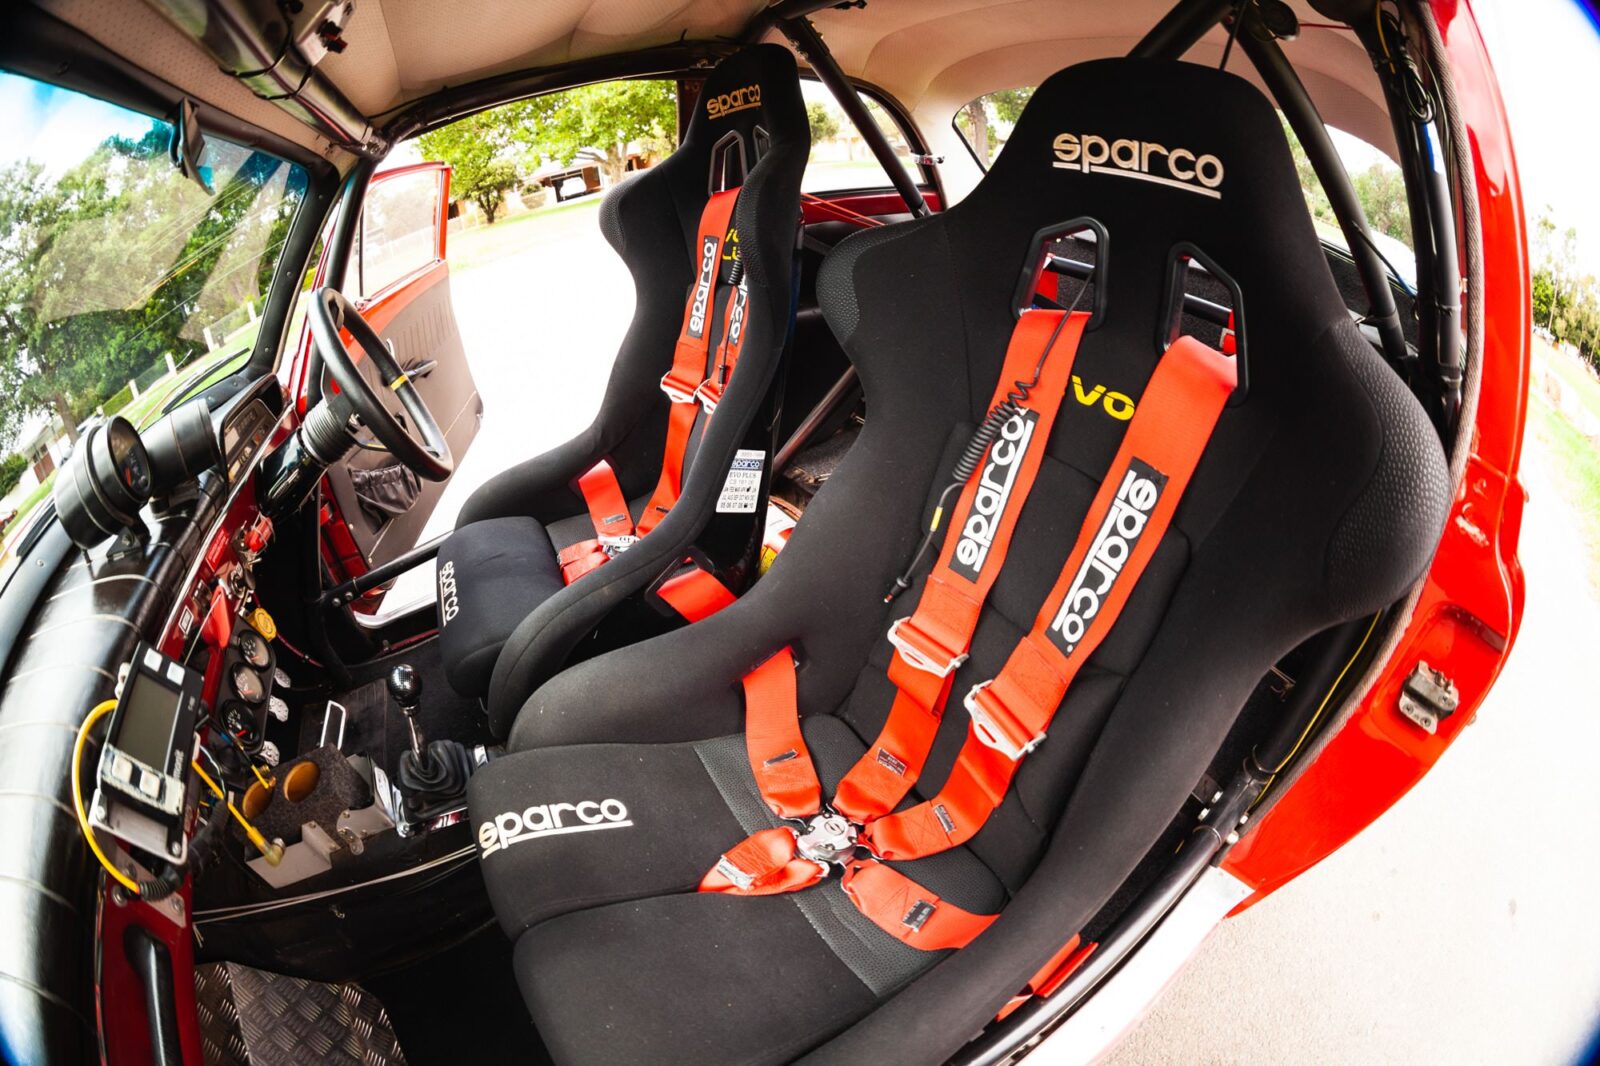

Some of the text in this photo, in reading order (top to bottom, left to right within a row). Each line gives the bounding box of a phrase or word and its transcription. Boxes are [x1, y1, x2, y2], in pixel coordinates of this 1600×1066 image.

[706, 84, 761, 119] sparco
[1052, 132, 1225, 198] sparco
[690, 242, 717, 334] sparco
[956, 410, 1035, 572] sparco
[1050, 469, 1158, 644] sparco
[439, 560, 460, 627] sparco
[478, 798, 633, 859] sparco
